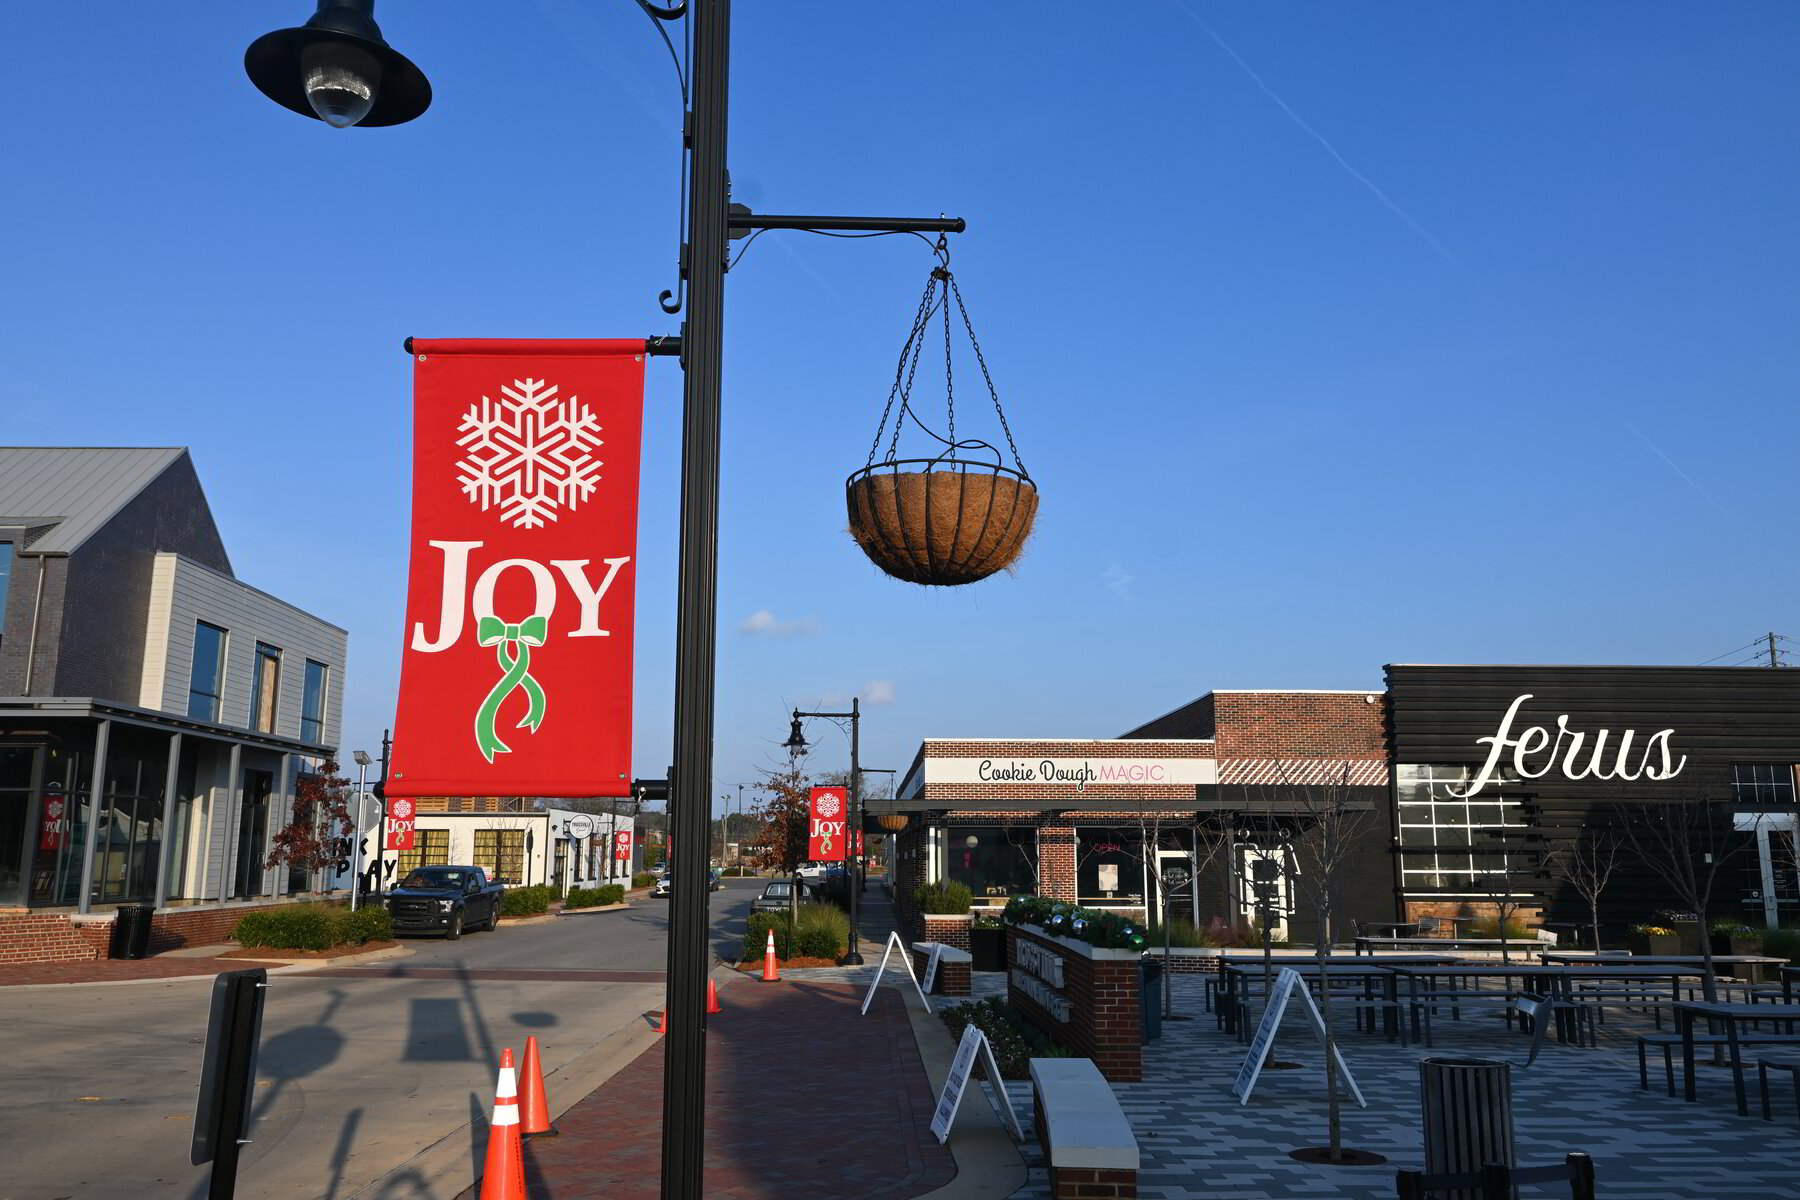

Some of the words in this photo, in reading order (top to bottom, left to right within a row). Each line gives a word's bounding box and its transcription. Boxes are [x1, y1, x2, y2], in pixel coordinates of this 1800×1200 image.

[411, 539, 630, 653] JOY
[1445, 694, 1687, 798] ferus
[978, 760, 1036, 781] Cookie
[1039, 760, 1097, 791] Dough
[1099, 765, 1164, 780] MAGIC
[388, 818, 415, 833] JOY
[811, 818, 845, 838] JOY
[616, 843, 629, 851] JOY
